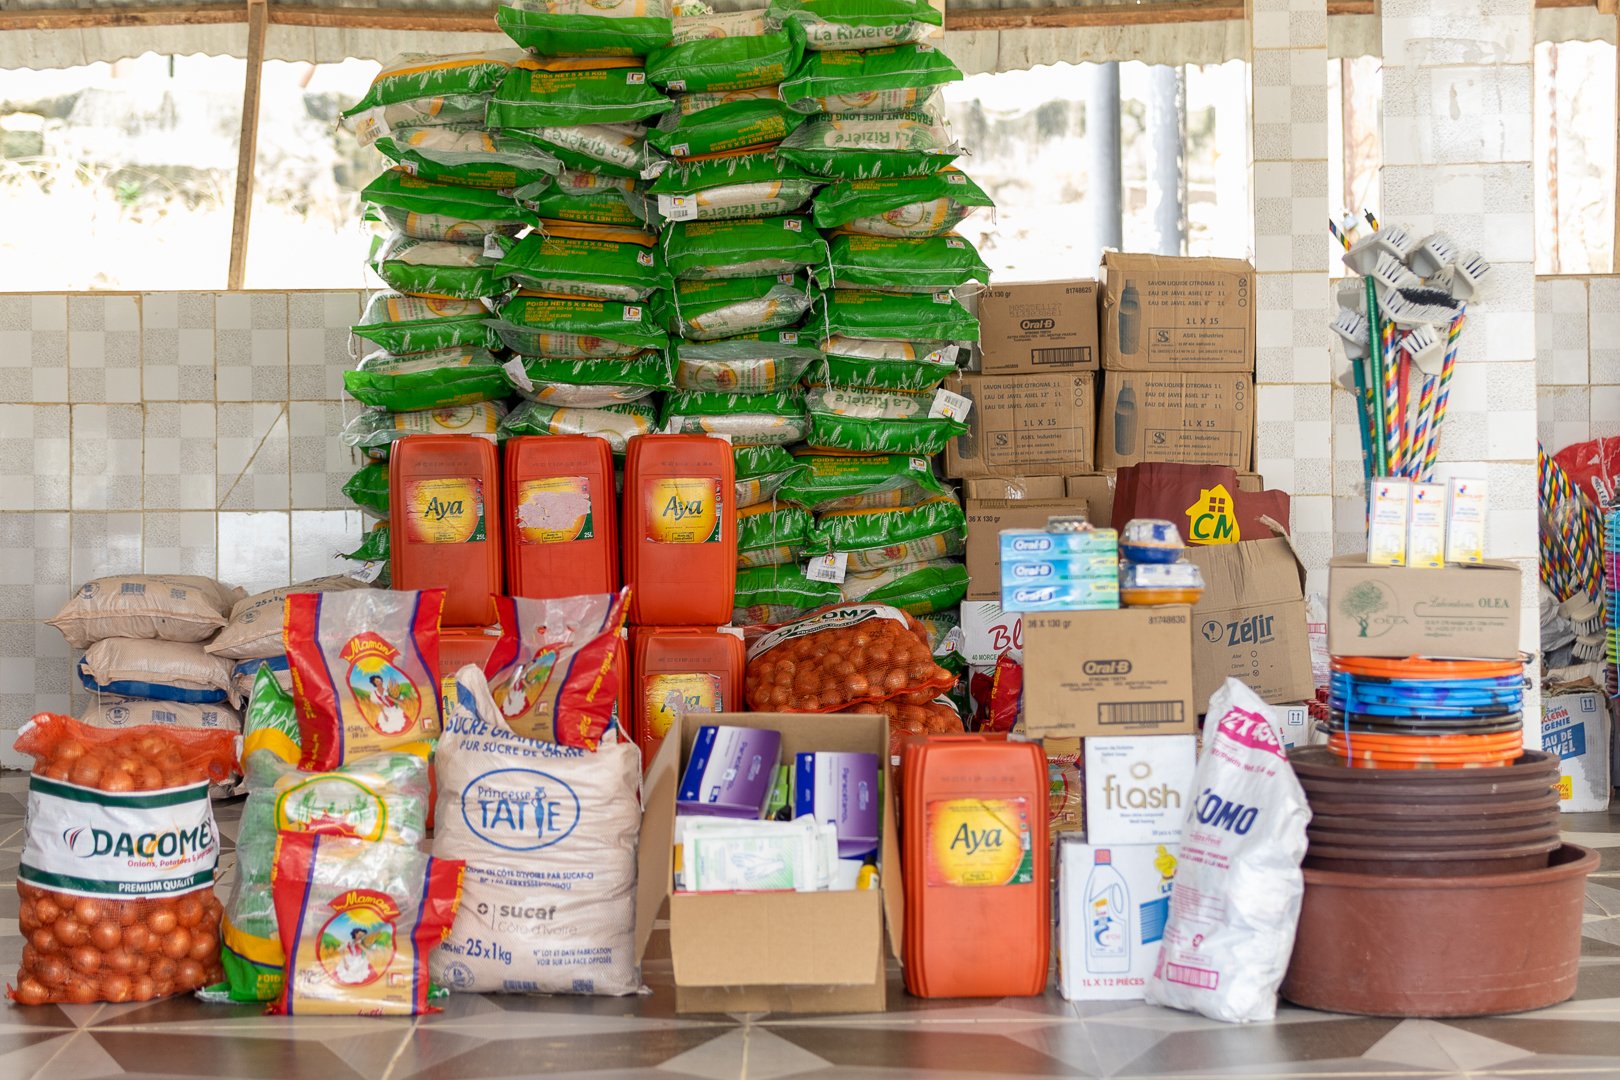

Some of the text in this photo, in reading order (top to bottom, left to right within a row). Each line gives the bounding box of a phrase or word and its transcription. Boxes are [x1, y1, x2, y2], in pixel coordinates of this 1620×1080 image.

[813, 27, 832, 41] La
[836, 111, 934, 127] FRAGRANT RICE LONG
[834, 131, 890, 145] Rizière
[1021, 319, 1053, 329] Oral-B
[424, 496, 464, 521] Aya
[662, 495, 704, 521] Aya
[968, 515, 977, 523] 36
[977, 515, 983, 523] X
[983, 515, 994, 523] 130
[1193, 513, 1234, 539] CM
[1015, 540, 1049, 550] Oral-B
[1016, 565, 1049, 576] Oral-B
[1016, 591, 1051, 601] Oral-B
[1478, 598, 1510, 609] OLEA
[1038, 620, 1045, 628] X
[1047, 619, 1061, 628] 130
[1062, 619, 1072, 630] gr
[1374, 617, 1409, 625] OLEA
[349, 637, 397, 656] Maman
[1084, 661, 1129, 674] Oral-B
[444, 714, 488, 736] SUCRE
[1560, 729, 1573, 741] DE
[459, 740, 479, 751] PUR
[482, 742, 519, 756] SUCRE
[523, 749, 538, 757] DE
[477, 785, 531, 801] Princesse
[1102, 774, 1181, 810] flash
[477, 799, 561, 833] TATIE
[949, 822, 1005, 856] Aya
[127, 859, 158, 868] Onions,
[159, 856, 191, 867] Potatoes
[496, 869, 594, 880] CÔTE D'IVOIRE PAR SUCAF-CI
[118, 876, 195, 893] PREMIUM QUALITY
[344, 890, 393, 915] Maman
[499, 904, 557, 920] sucaf
[257, 973, 281, 983] POID
[1094, 978, 1101, 986] X
[1103, 978, 1114, 986] 12
